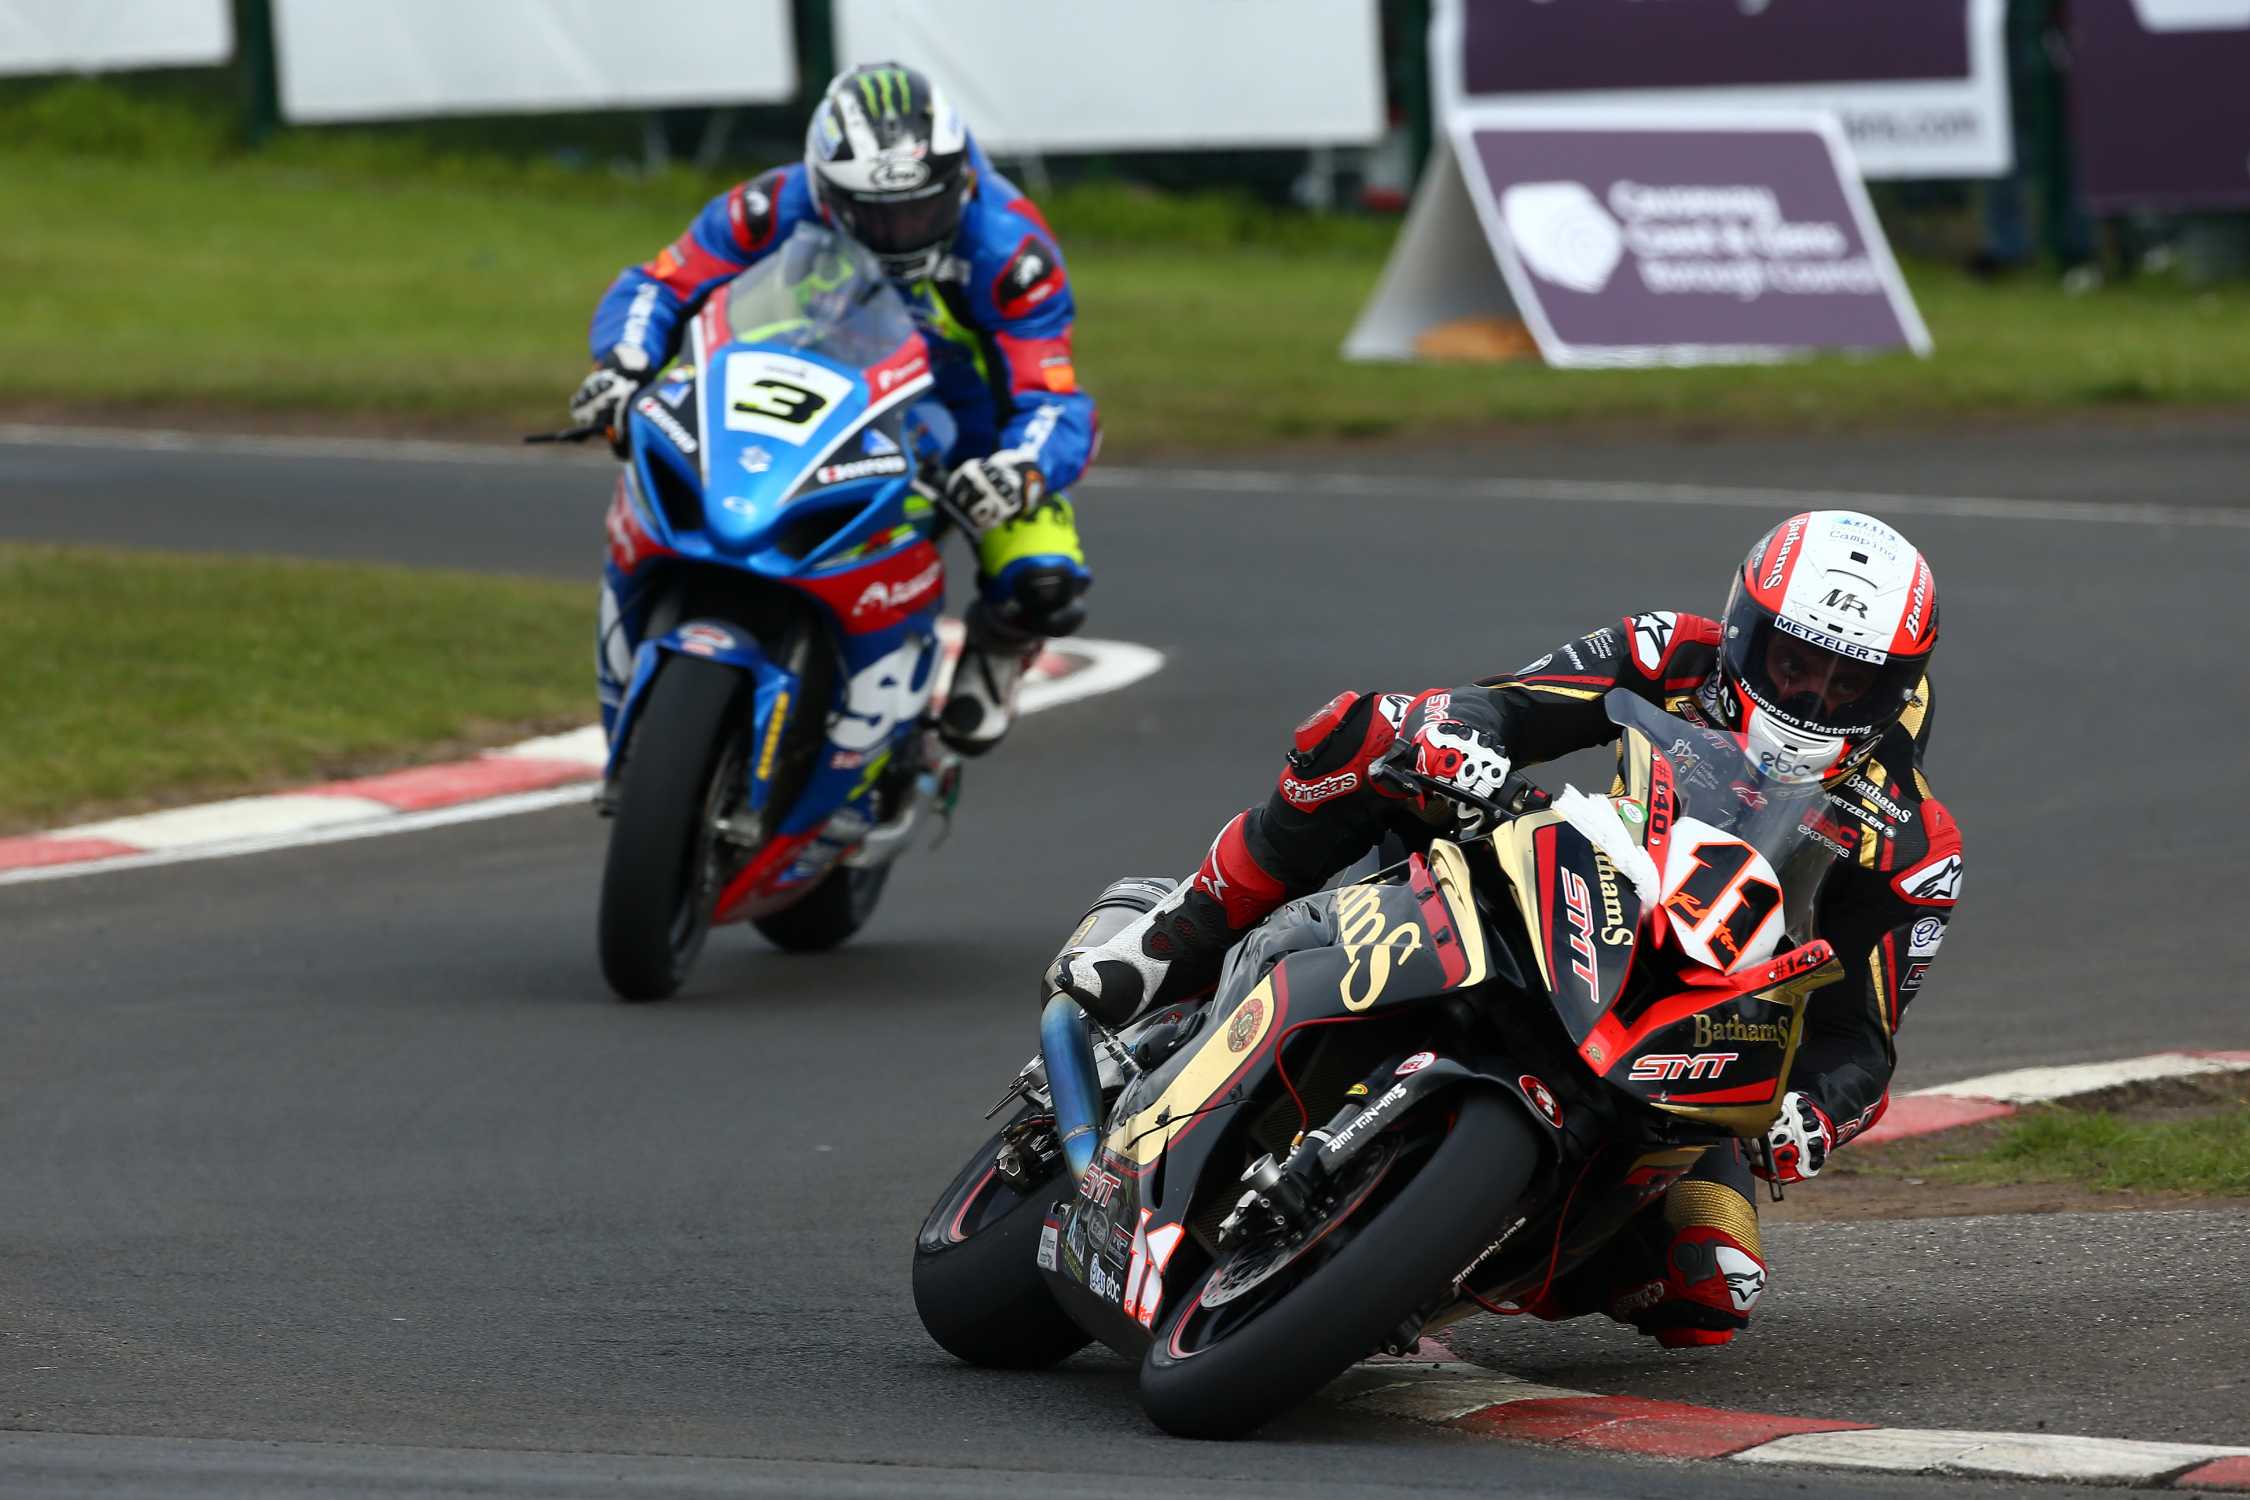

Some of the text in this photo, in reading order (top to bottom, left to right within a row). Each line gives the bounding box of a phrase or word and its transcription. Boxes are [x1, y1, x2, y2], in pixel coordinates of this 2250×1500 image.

[733, 378, 827, 424] 3
[1776, 616, 1870, 661] METZELER
[1740, 679, 1873, 736] Thompson Plastering
[1823, 793, 1886, 831] METZELER
[1660, 841, 1784, 976] 11
[1560, 866, 1600, 1004] SMT
[1628, 1052, 1740, 1081] SMT
[1326, 1083, 1408, 1153] METZELER
[1451, 1216, 1527, 1286] METZELER
[1105, 1270, 1121, 1304] ebc
